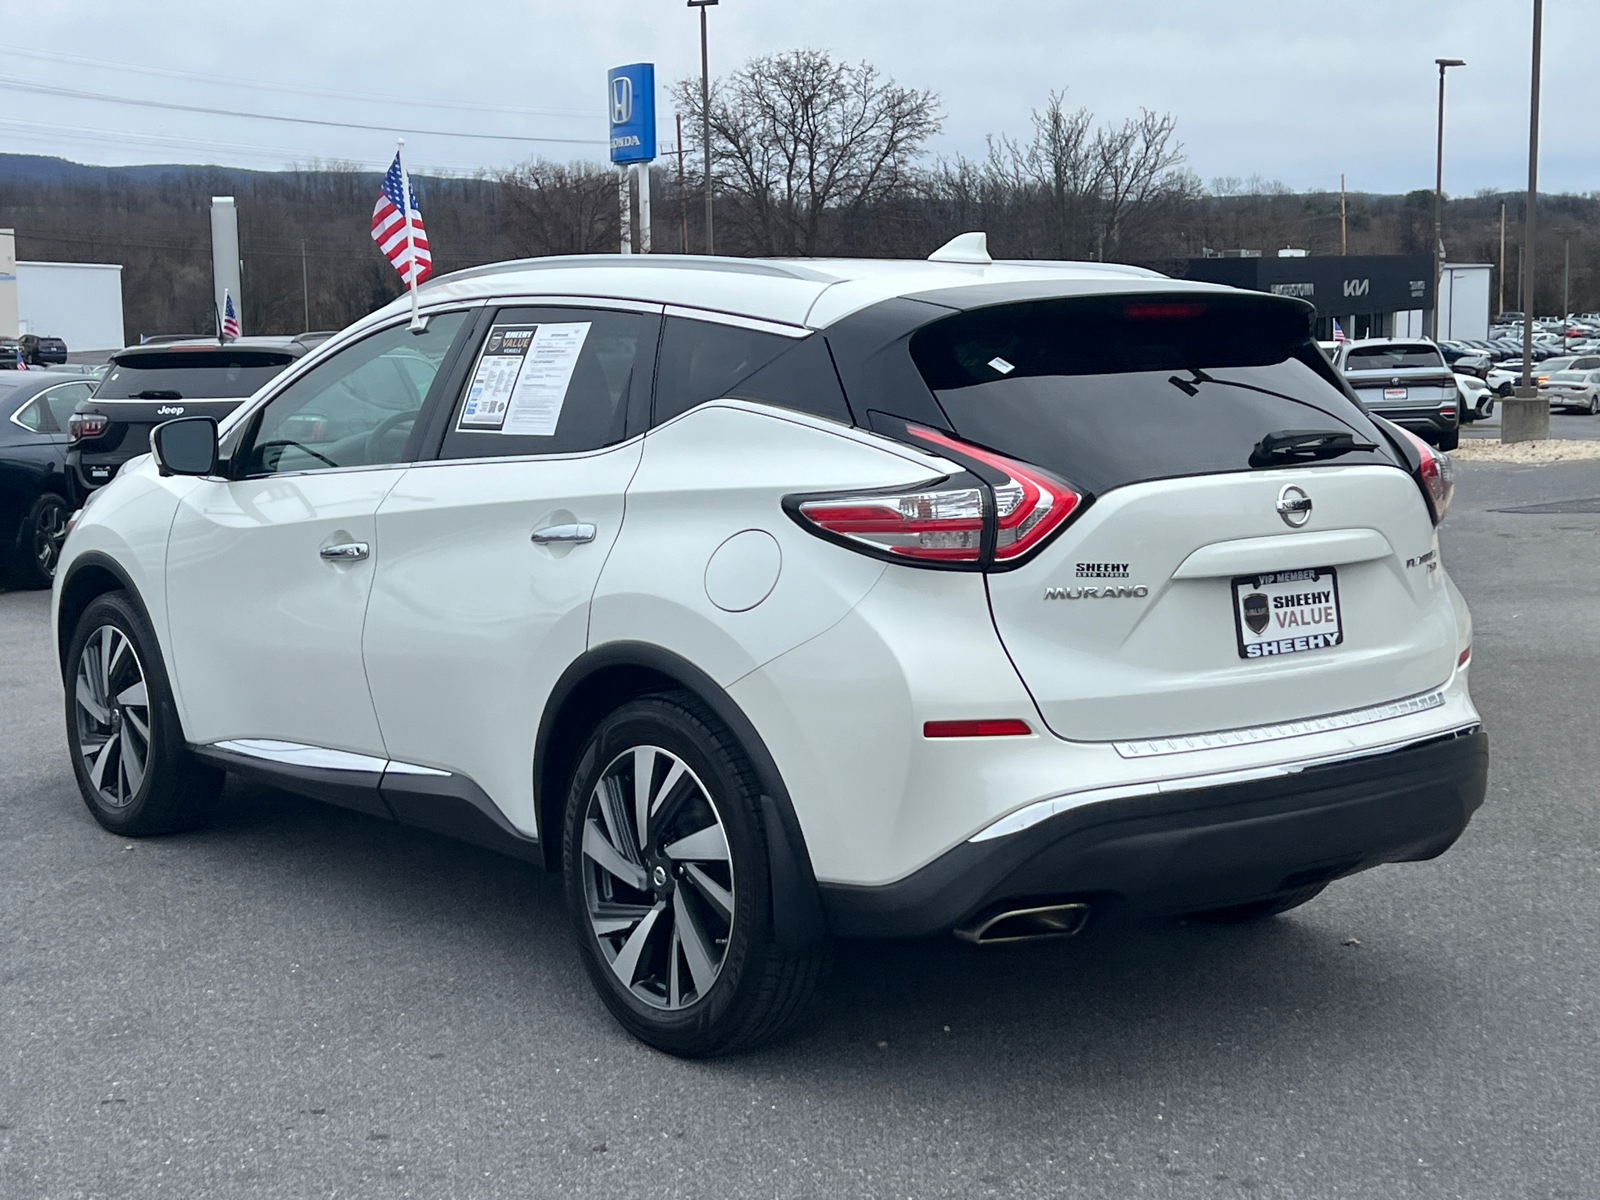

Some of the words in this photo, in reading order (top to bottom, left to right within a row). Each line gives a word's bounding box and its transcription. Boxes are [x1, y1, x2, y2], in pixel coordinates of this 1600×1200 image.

[502, 339, 530, 348] VALUE
[157, 405, 184, 416] Jeep
[1282, 501, 1309, 510] NIS
[1075, 563, 1129, 572] SHEEHY
[1259, 575, 1275, 584] VIP
[1277, 570, 1315, 582] MEMBER
[1043, 585, 1148, 600] MURANO
[1273, 591, 1331, 609] SHEEHY
[1275, 606, 1334, 628] VALUE
[1246, 633, 1339, 658] SHEEHY
